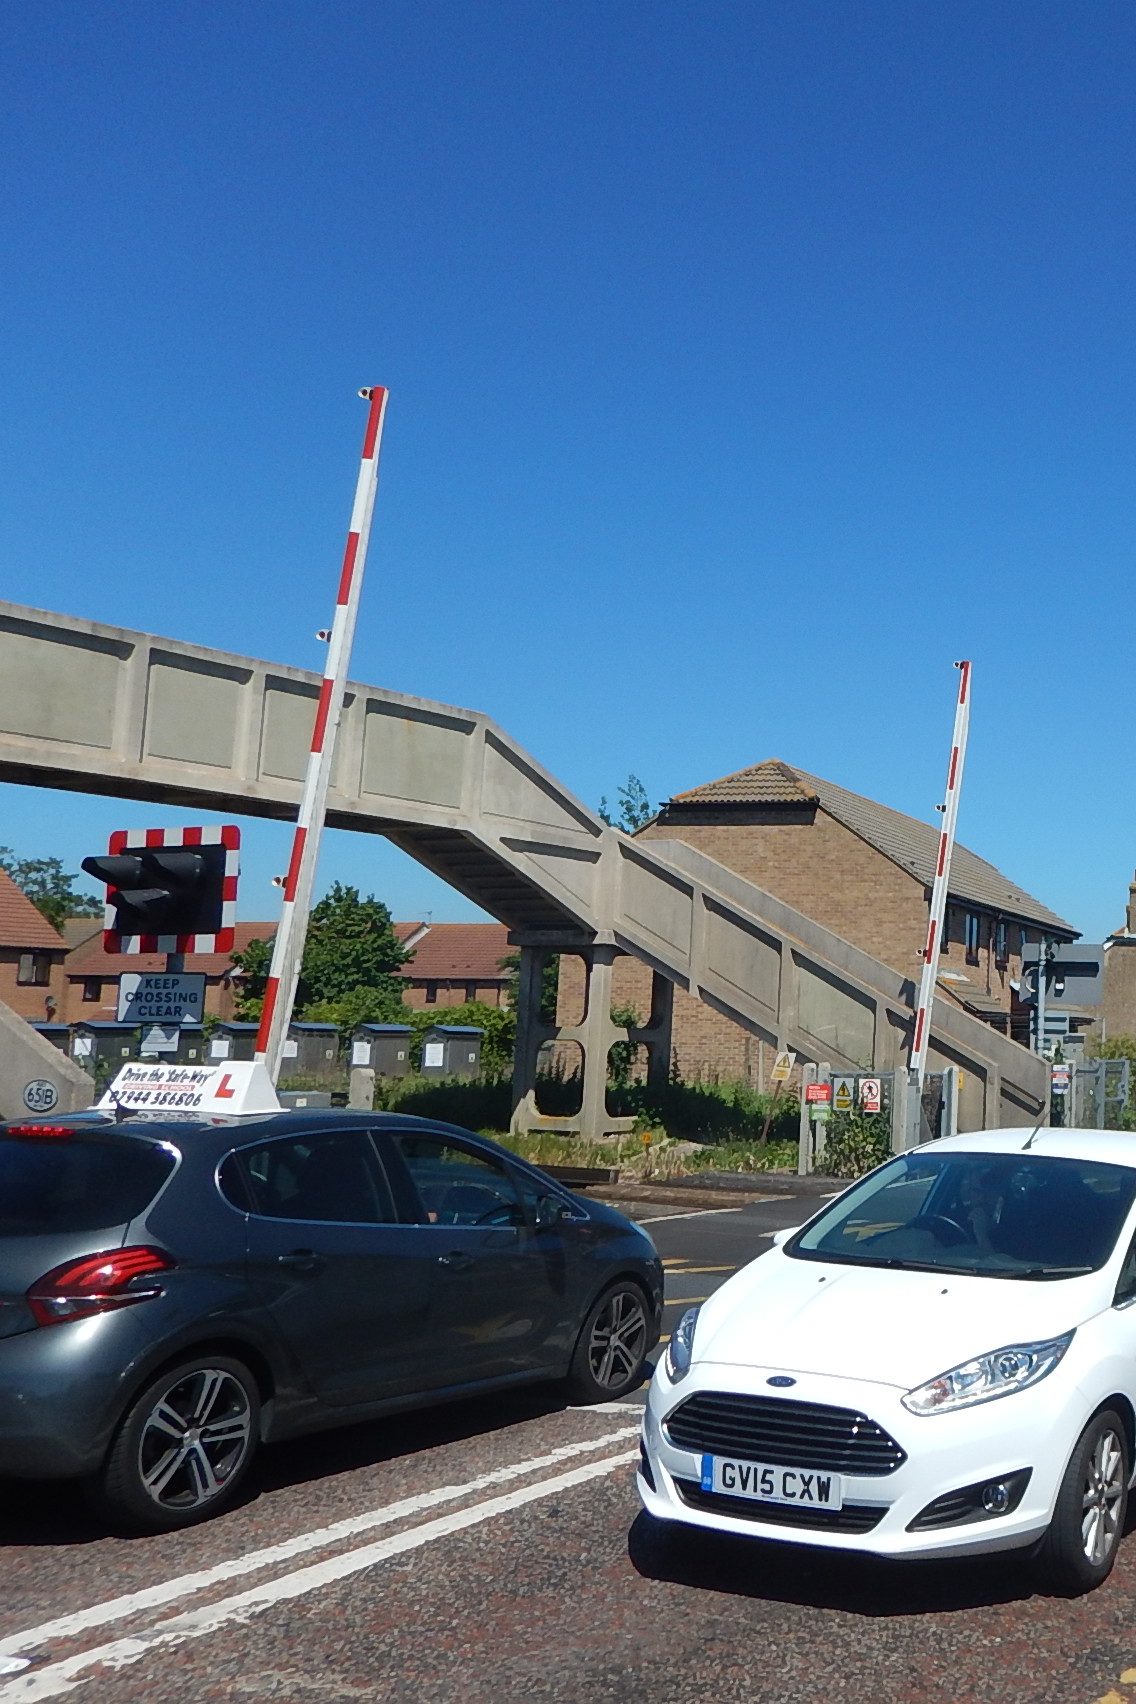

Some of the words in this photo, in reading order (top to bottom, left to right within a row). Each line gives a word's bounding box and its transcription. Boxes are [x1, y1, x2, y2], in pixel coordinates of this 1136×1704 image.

[145, 978, 179, 989] KEEP
[125, 991, 198, 1004] CROSSING
[138, 1005, 182, 1017] CLEAR
[122, 1067, 148, 1082] Drive
[147, 1067, 165, 1083] the
[214, 1074, 235, 1098] L
[722, 1462, 775, 1495] GV15
[782, 1471, 831, 1503] CXW
